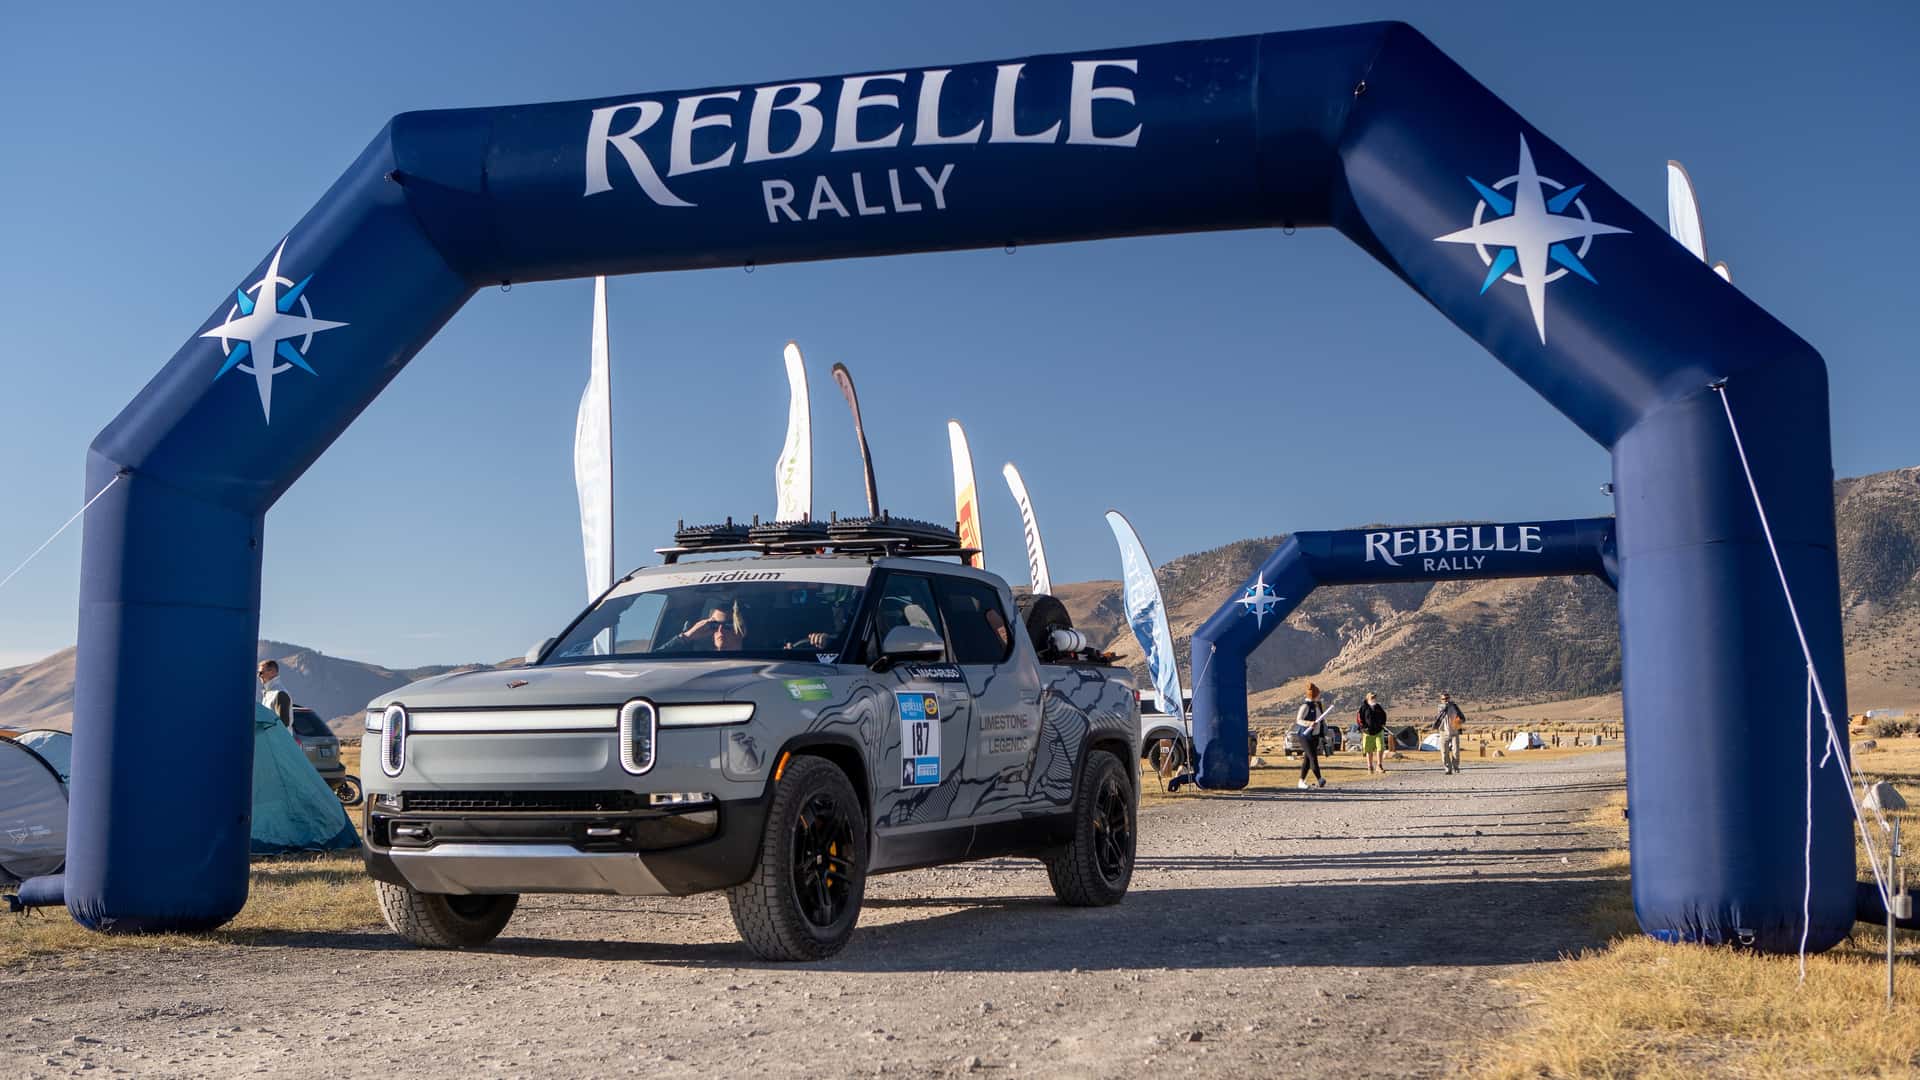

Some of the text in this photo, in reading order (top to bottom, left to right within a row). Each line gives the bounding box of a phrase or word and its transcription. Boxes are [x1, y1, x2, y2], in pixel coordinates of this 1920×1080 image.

[584, 59, 1143, 207] REBELLE
[761, 163, 955, 223] RALLY
[1365, 526, 1543, 566] REBELLE
[1423, 555, 1486, 571] RALLY
[700, 570, 781, 583] iridium
[979, 713, 1028, 731] LIMESTONE
[912, 722, 929, 756] 187
[988, 736, 1029, 754] LEGENDS
